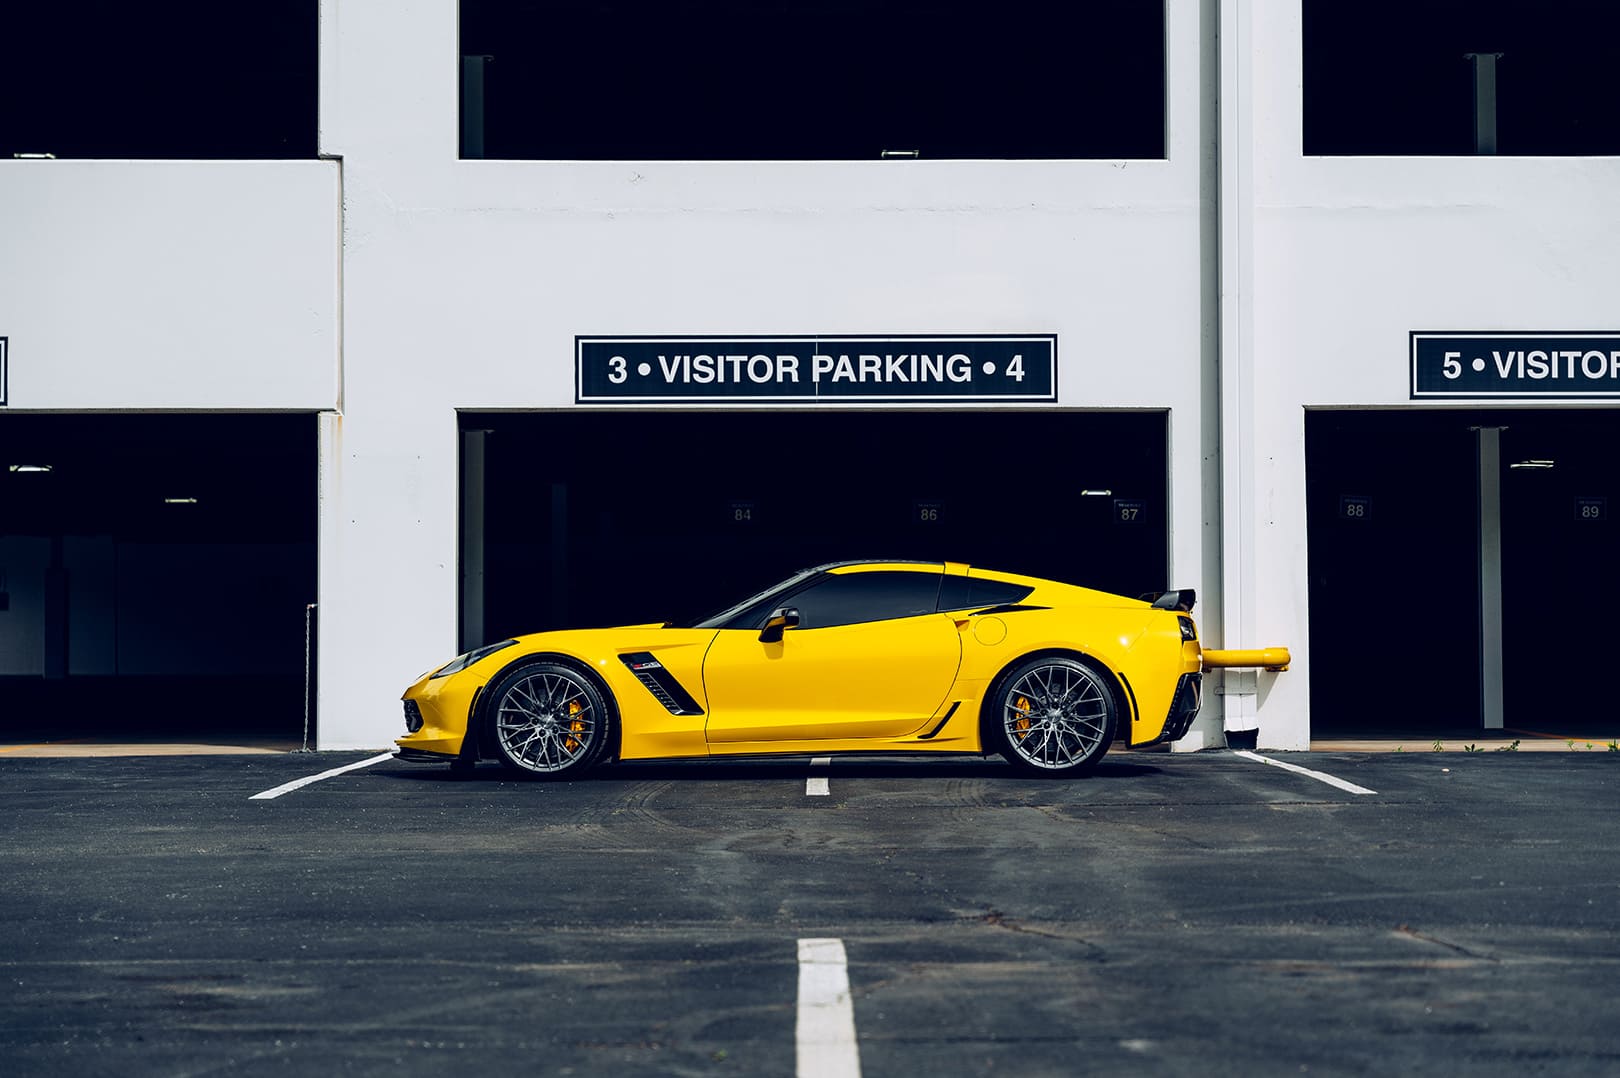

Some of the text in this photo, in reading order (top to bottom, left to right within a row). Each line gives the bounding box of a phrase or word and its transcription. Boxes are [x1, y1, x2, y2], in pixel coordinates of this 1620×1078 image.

[608, 354, 1026, 384] 3 VISITOR PARKING 4
[1442, 351, 1462, 380] 5
[735, 508, 751, 521] 84
[920, 508, 937, 521] 86
[1121, 508, 1139, 521] 87
[1347, 504, 1364, 517] 88
[1582, 505, 1599, 518] 89
